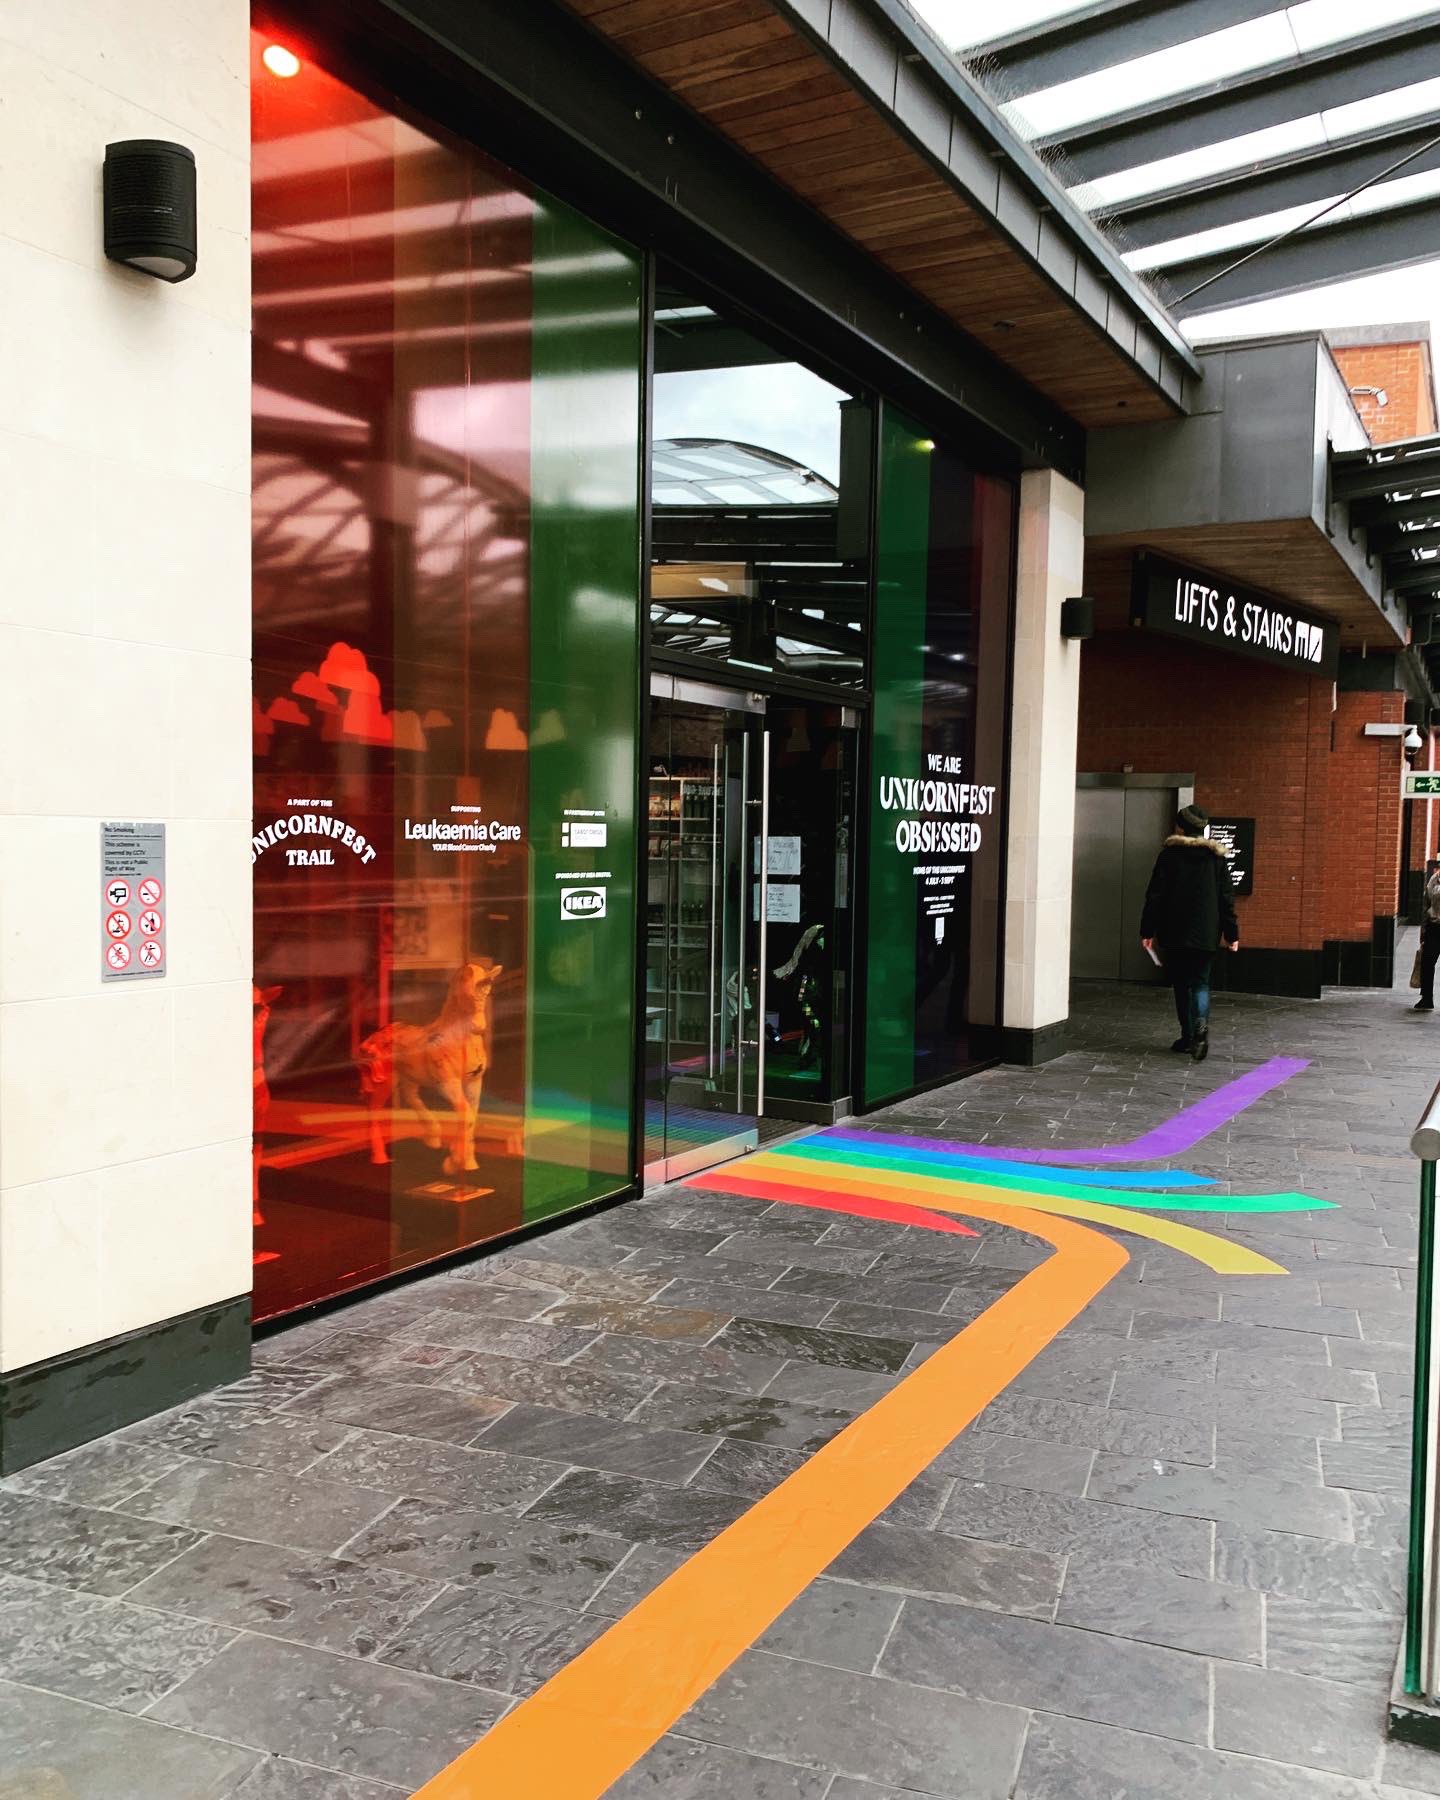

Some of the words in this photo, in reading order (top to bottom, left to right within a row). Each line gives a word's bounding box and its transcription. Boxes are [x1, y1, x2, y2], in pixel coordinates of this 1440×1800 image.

[1175, 578, 1219, 631] LIFTS
[1223, 596, 1237, 637] &
[1241, 602, 1292, 654] STAIRS
[928, 754, 942, 772] WE
[943, 756, 961, 774] ARE
[310, 799, 320, 807] OF
[880, 776, 995, 815] UNICORNFEST
[405, 819, 487, 840] Leukaemia
[489, 821, 521, 841] Care
[896, 820, 982, 853] OBSESSED
[432, 843, 447, 851] YOUR
[286, 850, 334, 866] TRAIL
[565, 896, 603, 910] IKEA
